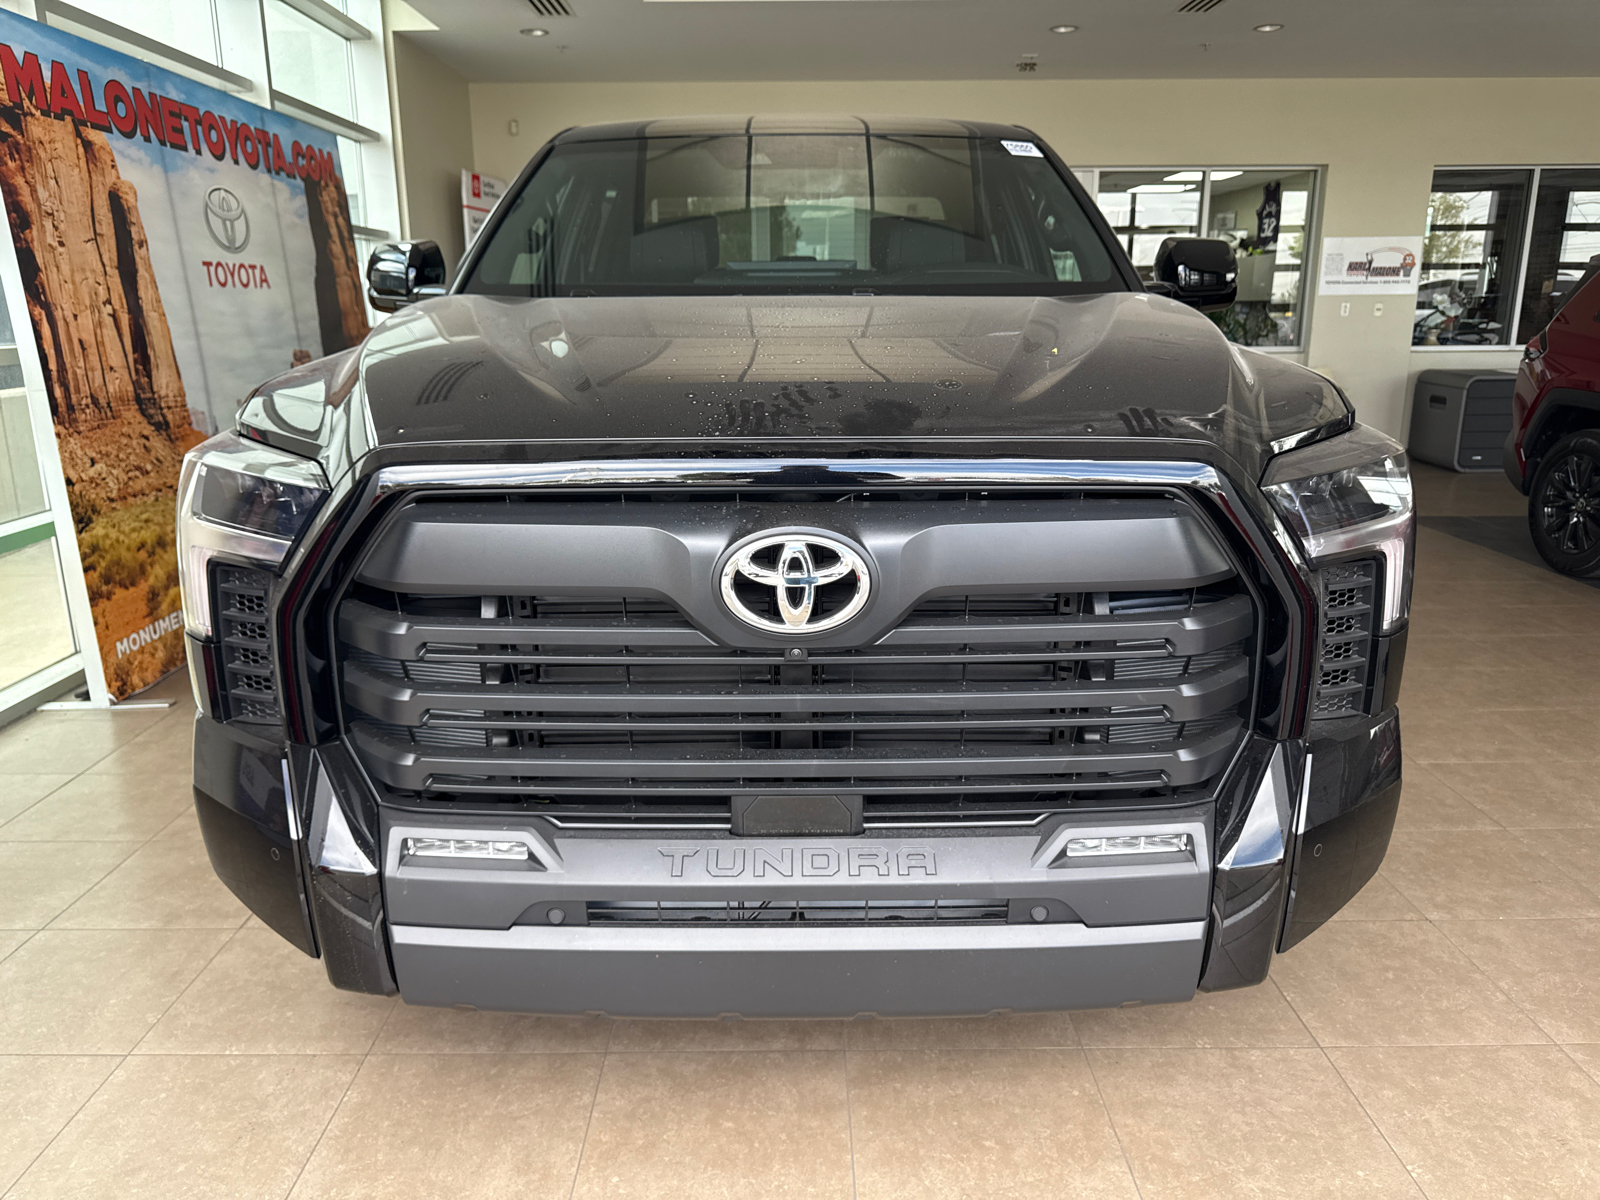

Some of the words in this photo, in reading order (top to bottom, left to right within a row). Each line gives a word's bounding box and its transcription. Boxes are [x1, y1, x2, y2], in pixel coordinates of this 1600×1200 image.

[0, 43, 338, 183] MALONETOYOTA.COM
[1260, 217, 1277, 237] 32
[202, 260, 271, 289] TOYOTA
[657, 846, 938, 878] TUNDRA
